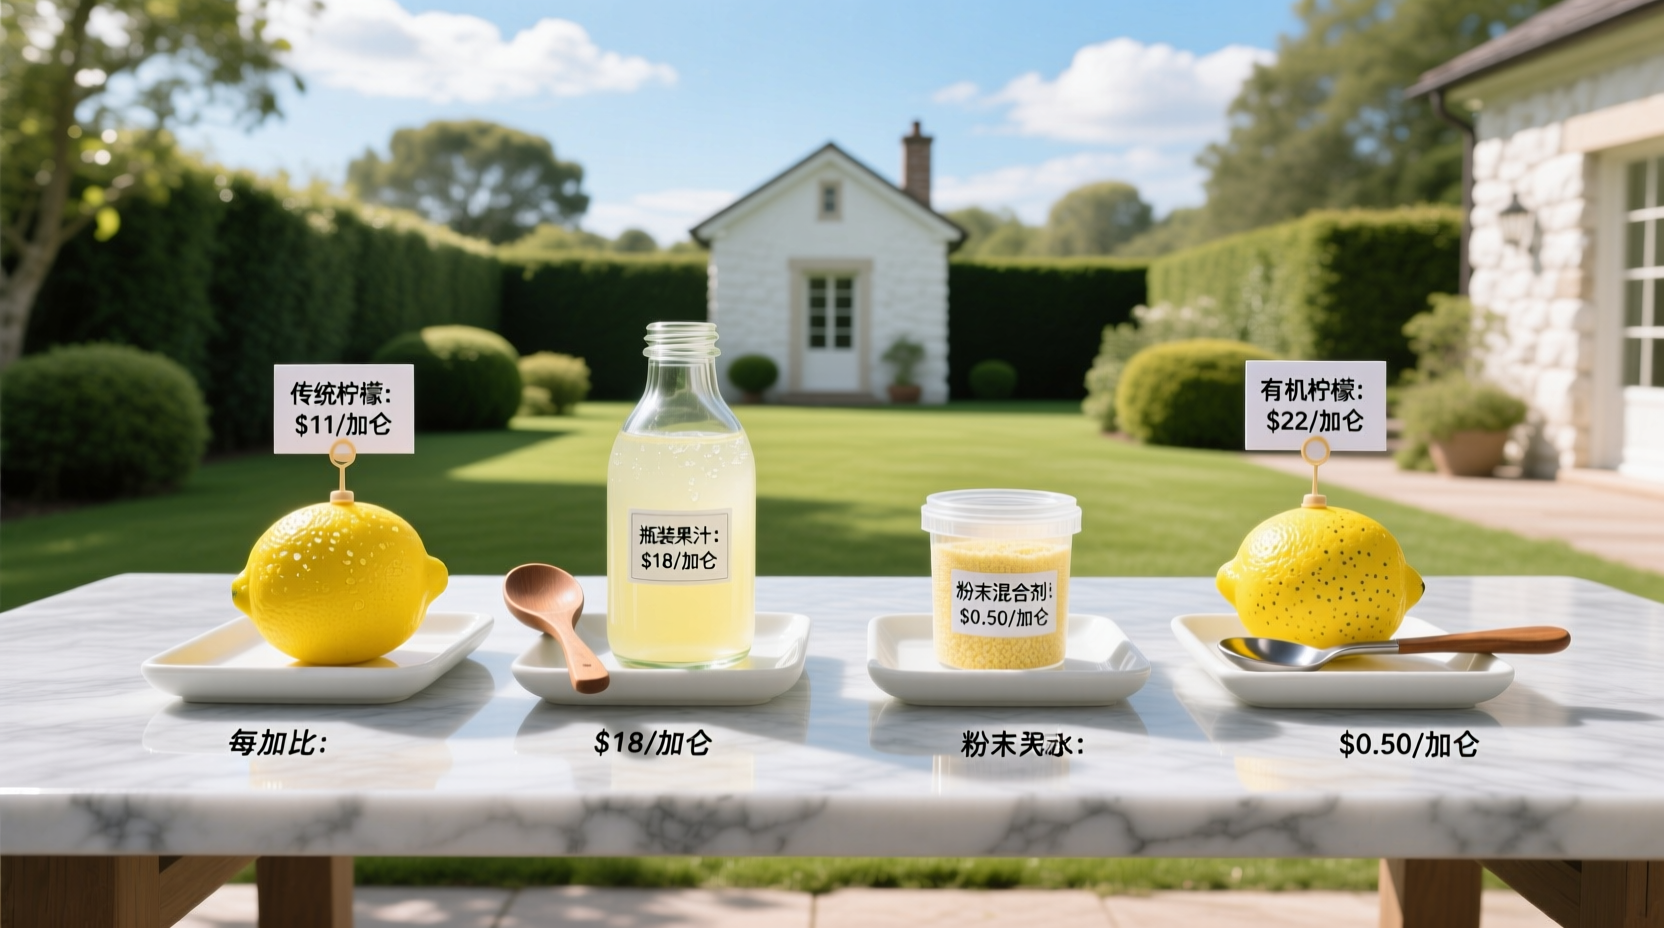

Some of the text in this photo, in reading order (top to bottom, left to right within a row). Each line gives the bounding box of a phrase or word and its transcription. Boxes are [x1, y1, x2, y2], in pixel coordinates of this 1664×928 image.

[290, 381, 391, 406] 传统柠檬:
[1261, 378, 1363, 403] 有机柠檬:
[295, 411, 391, 437] $11/加仑
[1267, 408, 1364, 433] $22/加仑
[639, 525, 719, 546] 瓶装果汁:
[641, 550, 718, 571] $18/加仑
[960, 608, 1049, 629] $0.50/加仑
